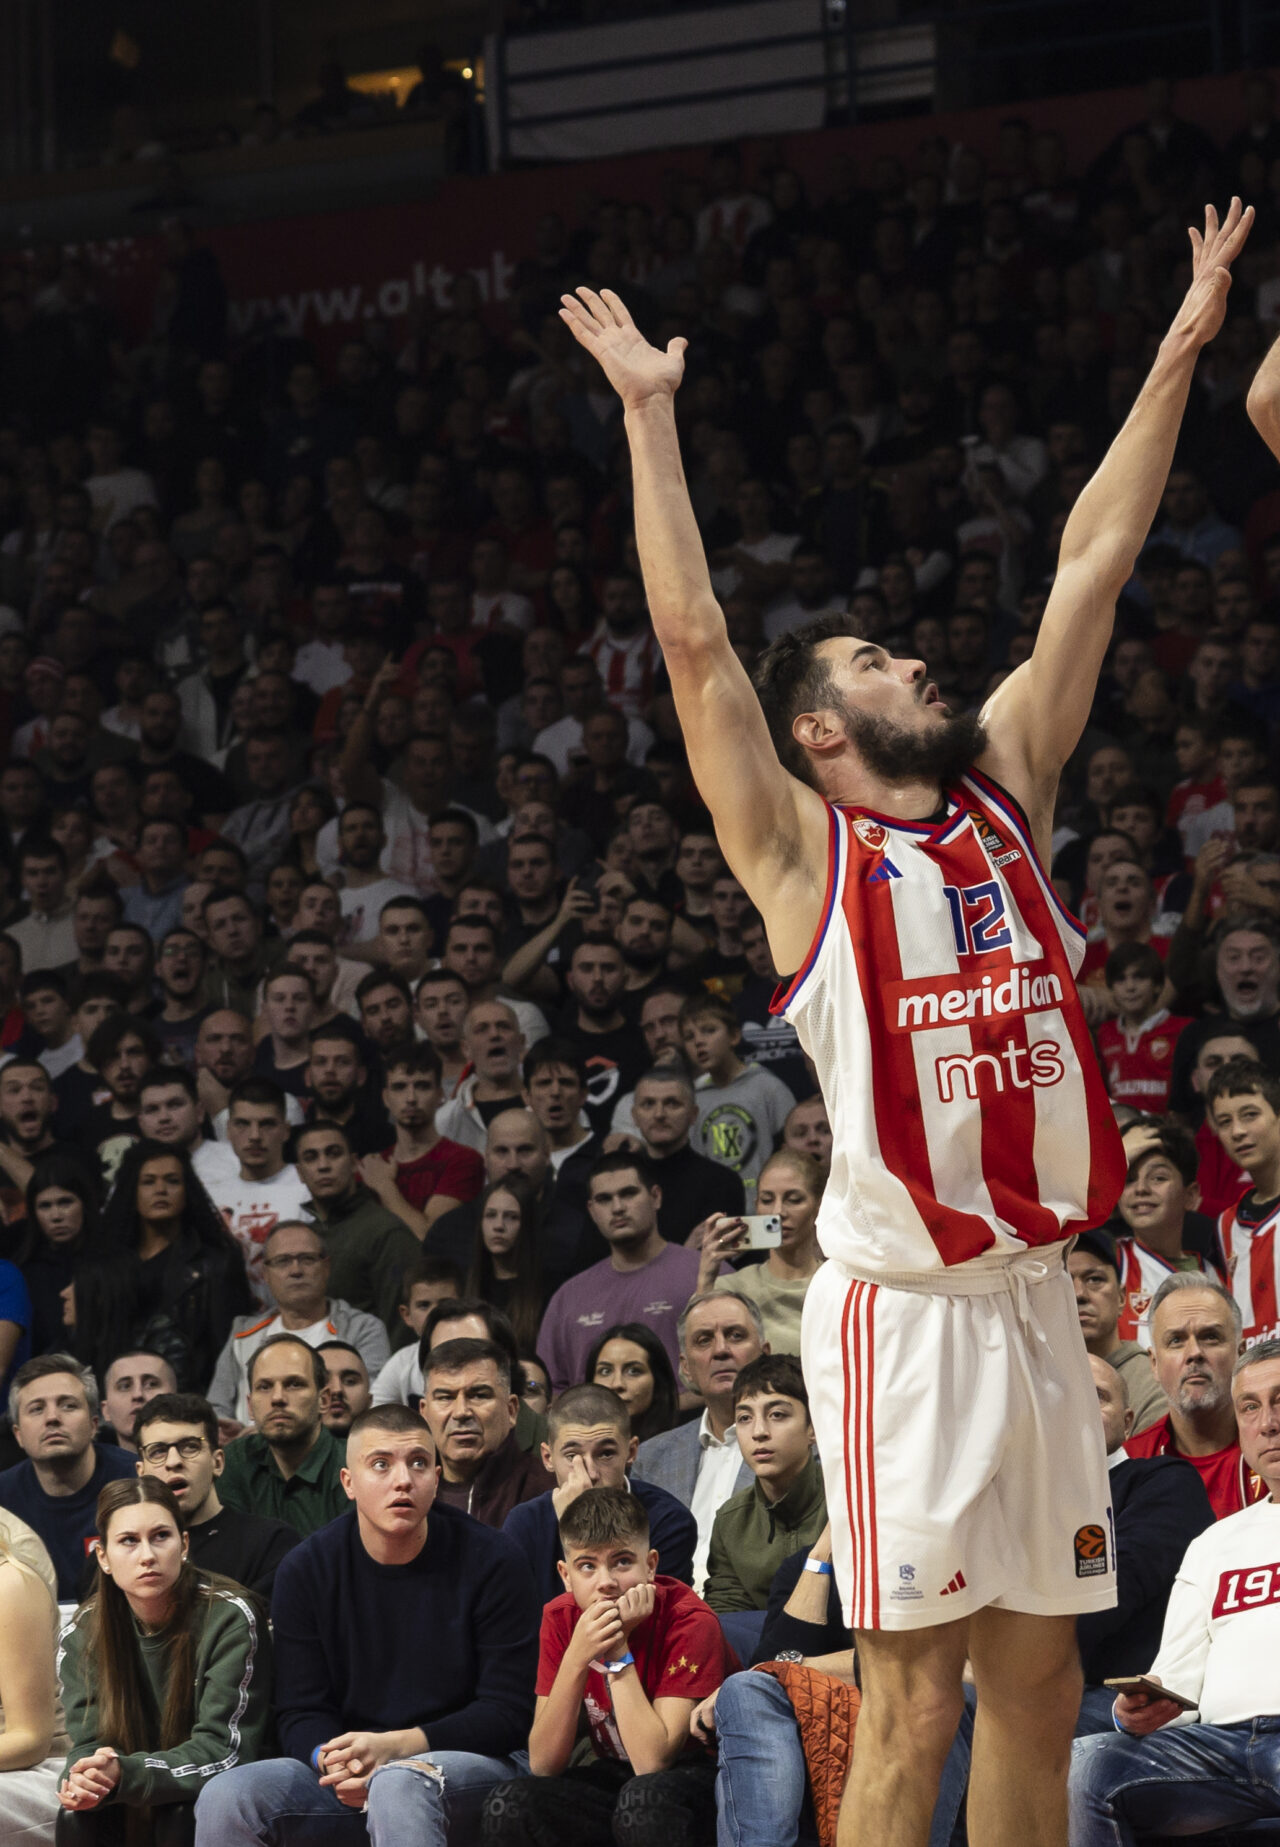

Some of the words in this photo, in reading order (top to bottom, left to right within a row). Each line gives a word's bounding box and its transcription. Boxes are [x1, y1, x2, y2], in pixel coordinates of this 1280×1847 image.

[943, 880, 1013, 956] 12
[898, 967, 1063, 1027] meridian
[936, 1037, 1064, 1102] mts
